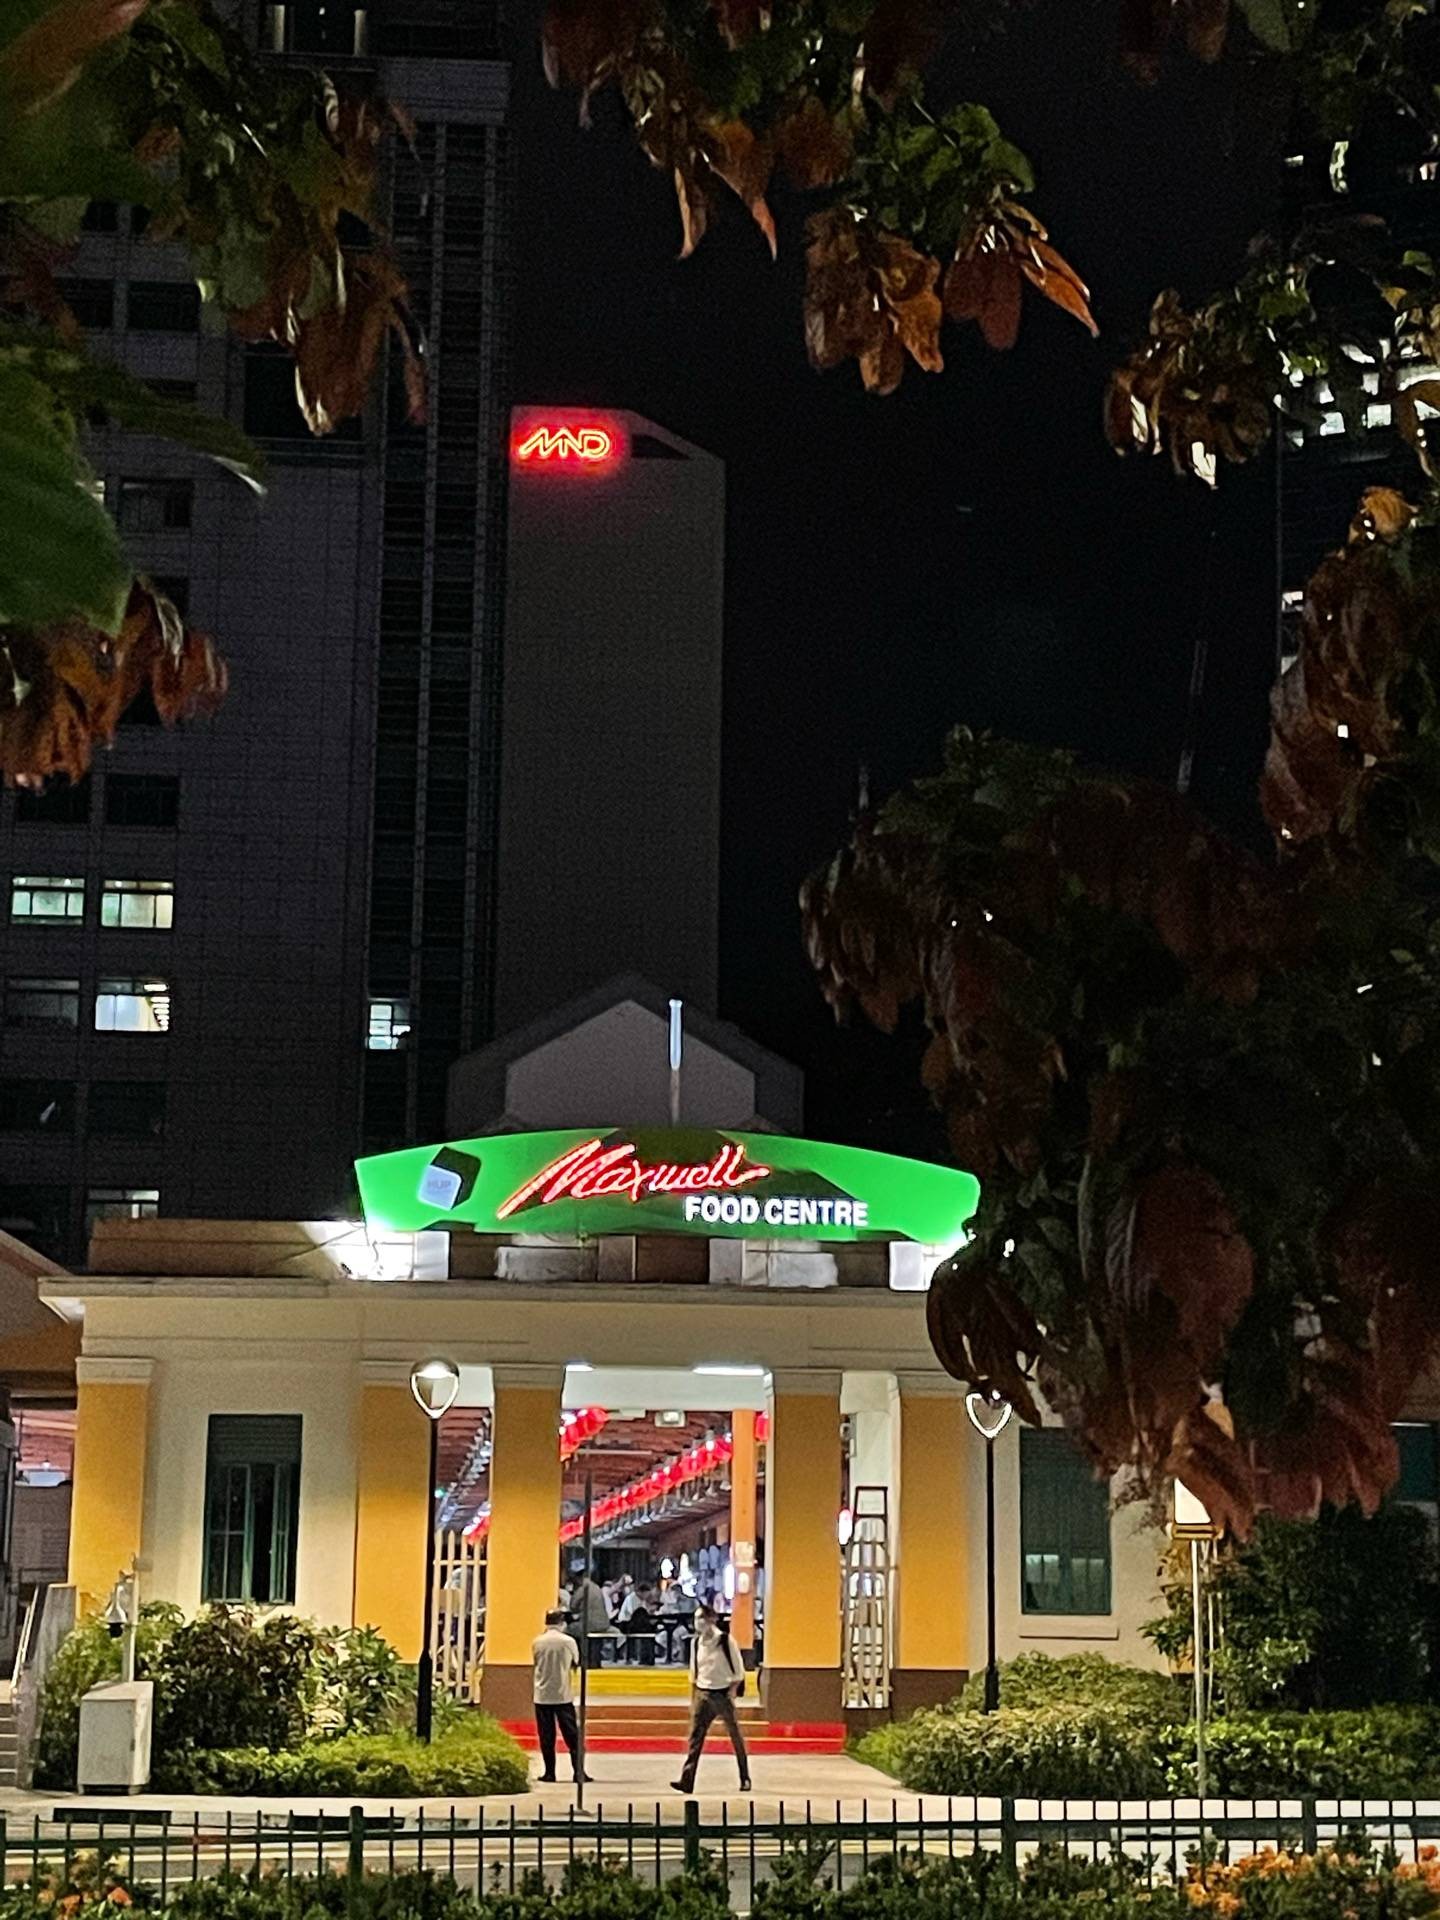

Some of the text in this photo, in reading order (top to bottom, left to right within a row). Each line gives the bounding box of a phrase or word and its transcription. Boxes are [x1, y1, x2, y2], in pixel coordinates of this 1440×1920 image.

[518, 428, 611, 459] MND
[496, 1138, 770, 1220] Maxwell
[684, 1195, 868, 1227] FOOD CENTRE
